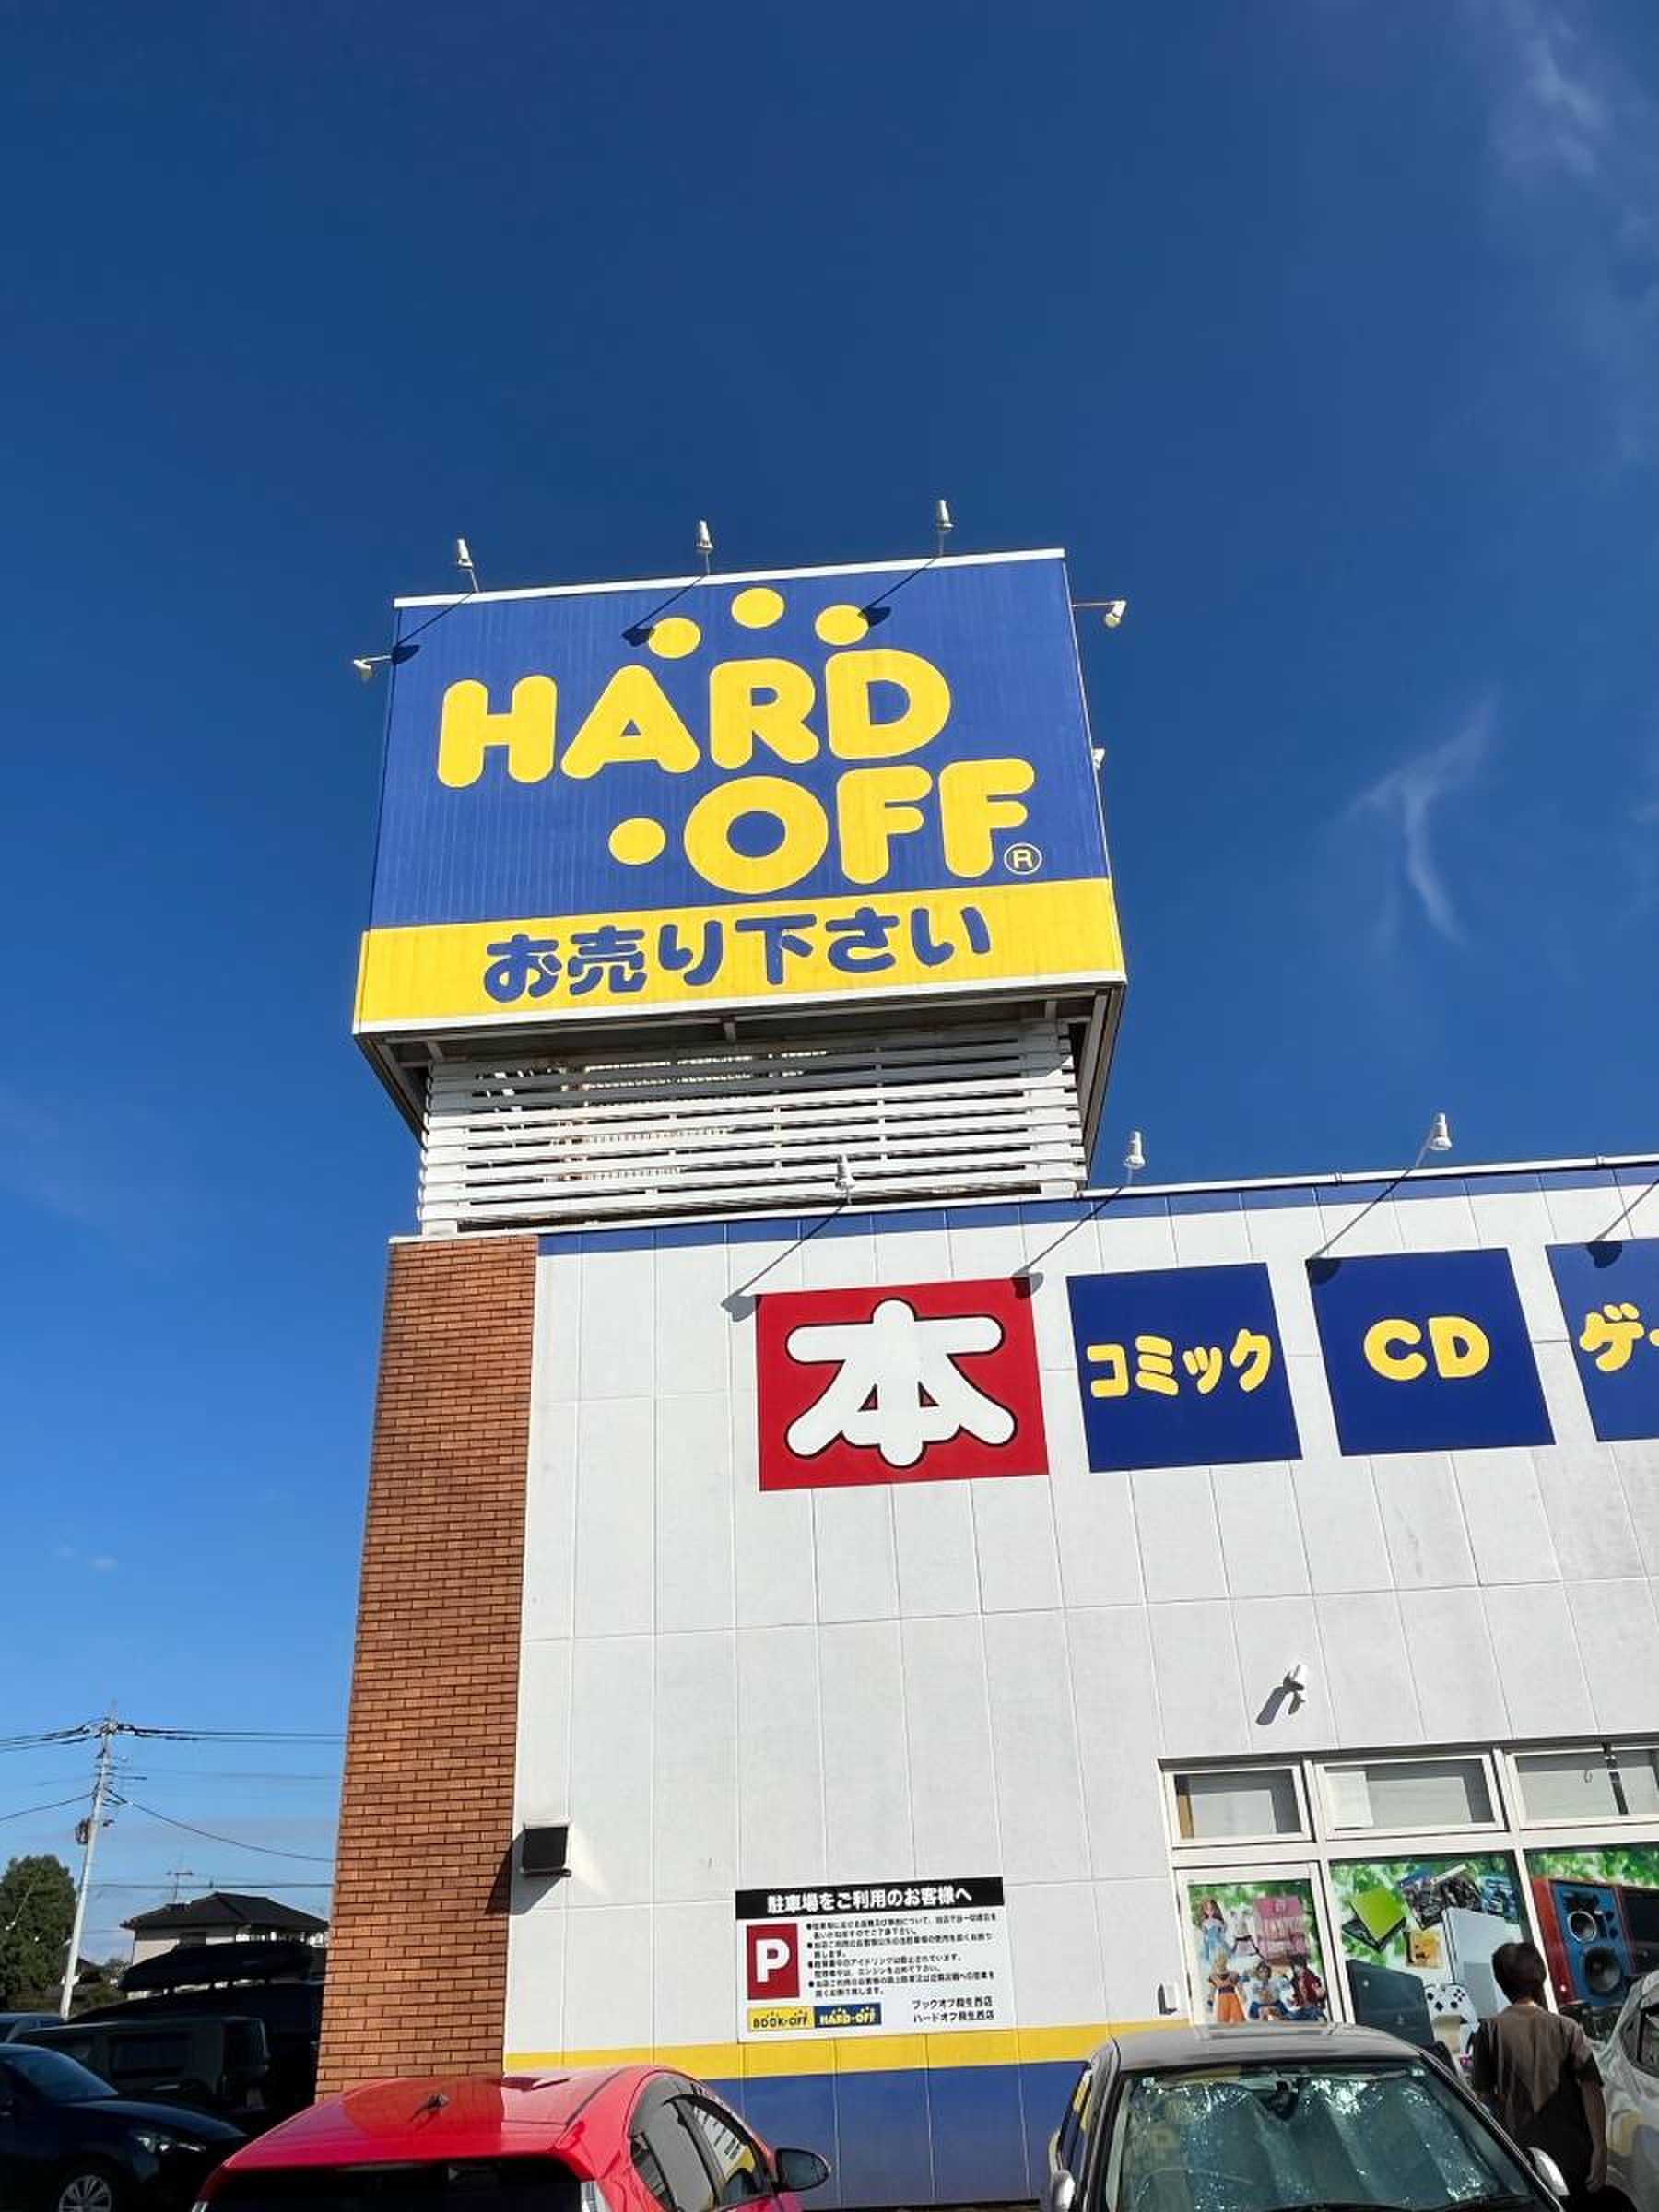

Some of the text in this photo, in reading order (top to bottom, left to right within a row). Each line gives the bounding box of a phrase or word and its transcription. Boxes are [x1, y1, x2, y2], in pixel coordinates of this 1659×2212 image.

[438, 648, 951, 789] HARD
[483, 906, 991, 1002] お売り下さい
[1088, 1330, 1273, 1399] コミック
[1365, 1316, 1491, 1382] CD
[1579, 1302, 1659, 1372] ゲ
[785, 1296, 1018, 1467] 本
[767, 1885, 973, 1914] 駐車場をご利用のお客様へ
[756, 1937, 791, 1983] P
